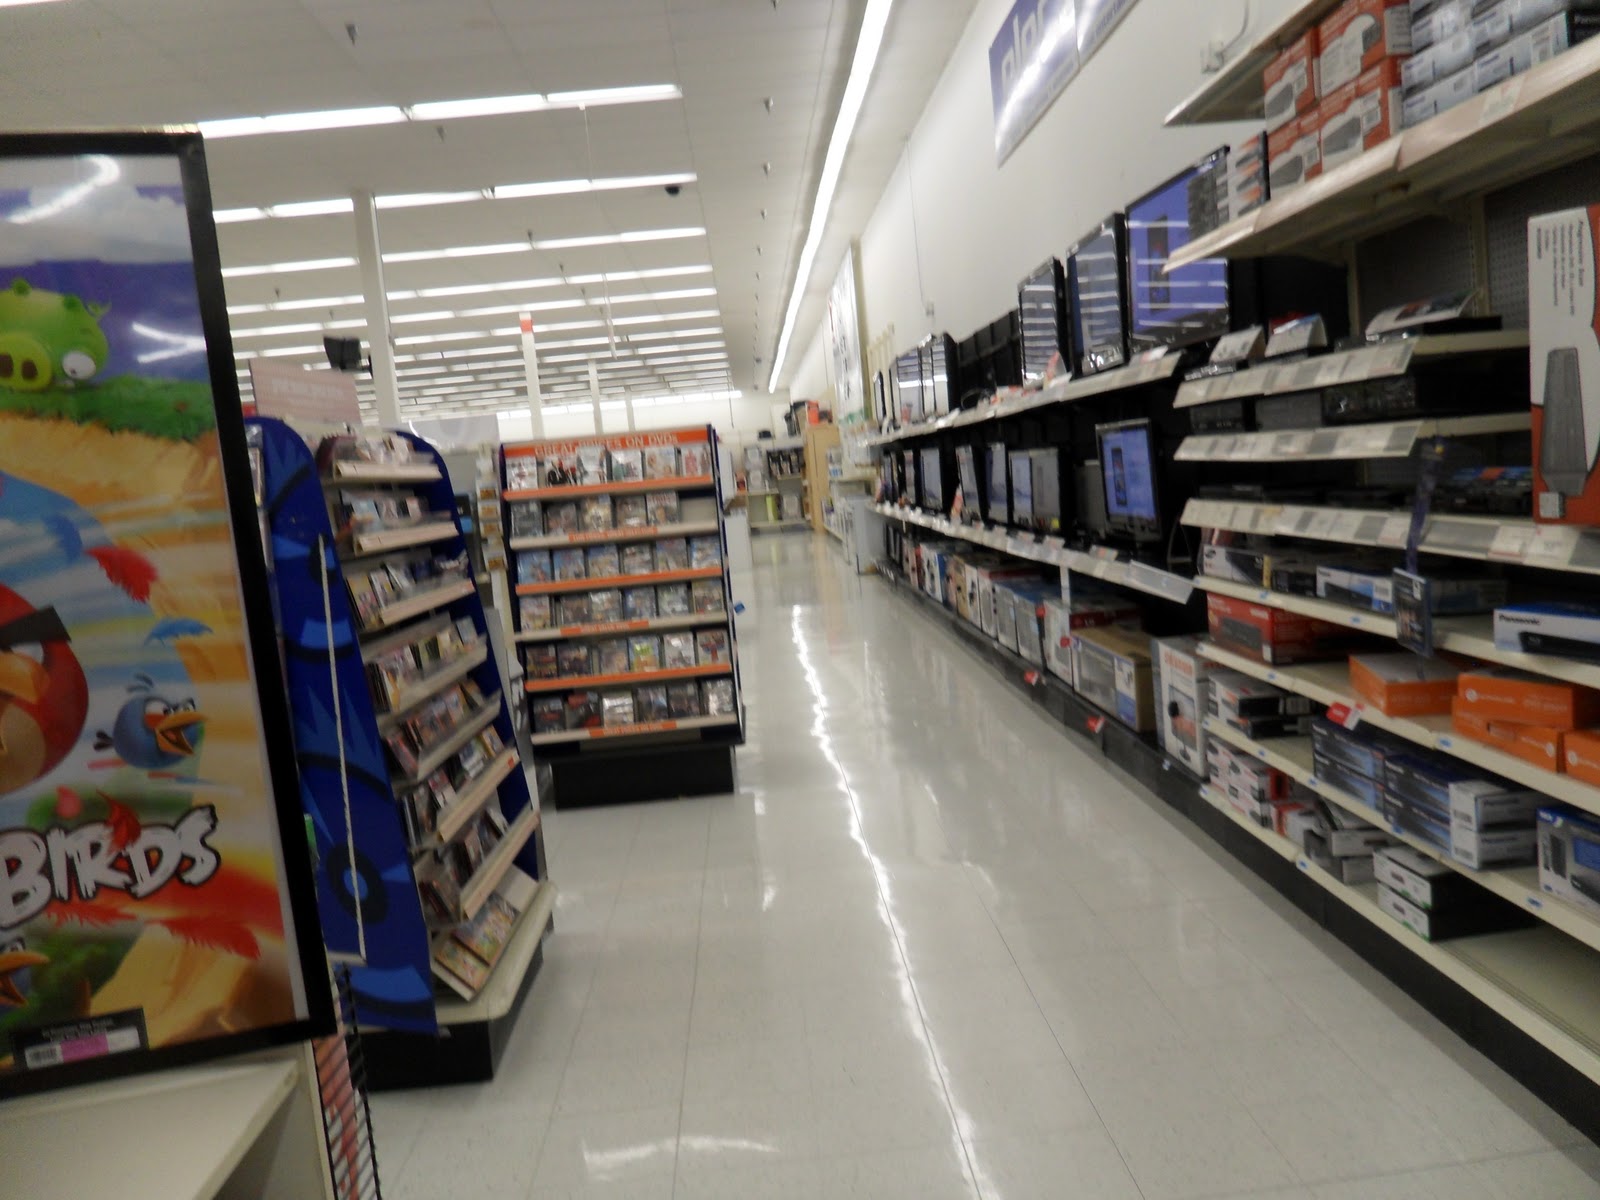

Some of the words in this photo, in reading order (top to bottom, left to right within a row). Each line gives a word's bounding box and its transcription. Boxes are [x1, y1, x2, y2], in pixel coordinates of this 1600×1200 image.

[534, 443, 577, 456] GREAT
[626, 435, 644, 448] ON
[648, 433, 679, 447] DVDs
[0, 804, 220, 930] BIRDS
